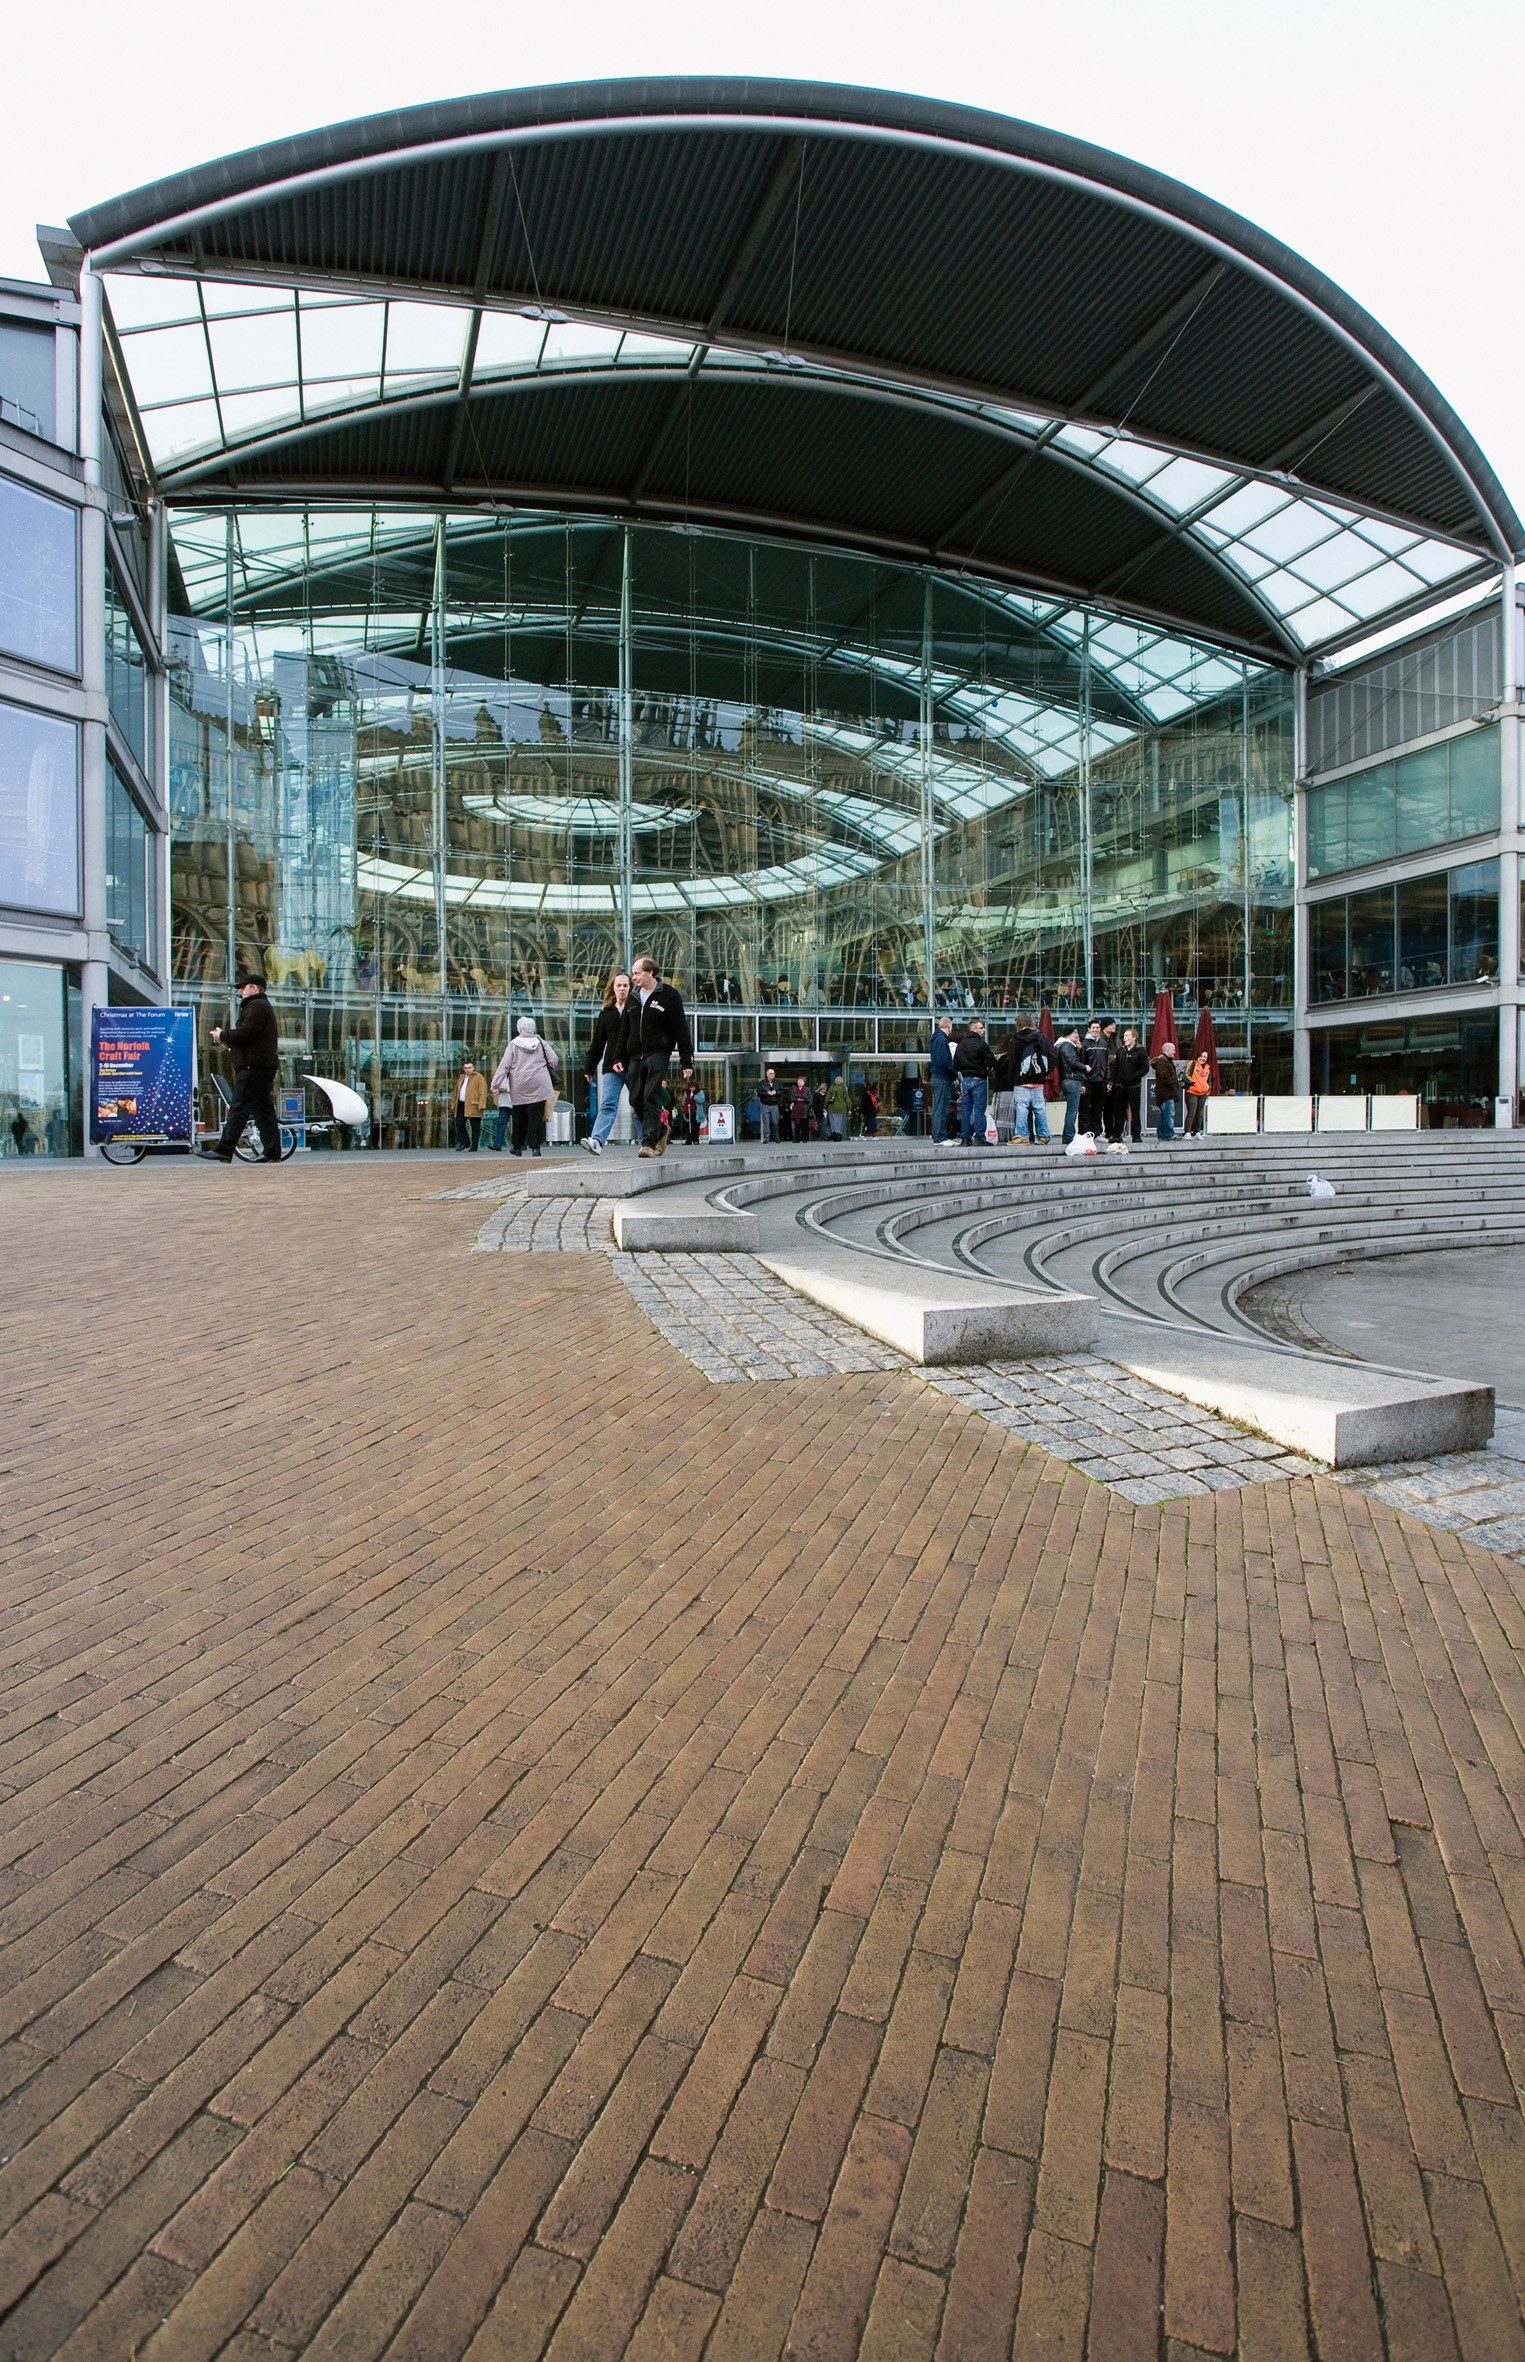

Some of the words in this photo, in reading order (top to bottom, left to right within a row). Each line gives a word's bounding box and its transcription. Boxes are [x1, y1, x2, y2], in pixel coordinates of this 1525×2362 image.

[99, 1041, 116, 1050] The
[117, 1041, 150, 1050] Norfolk
[99, 1051, 122, 1060] Craft
[123, 1051, 141, 1060] Fair
